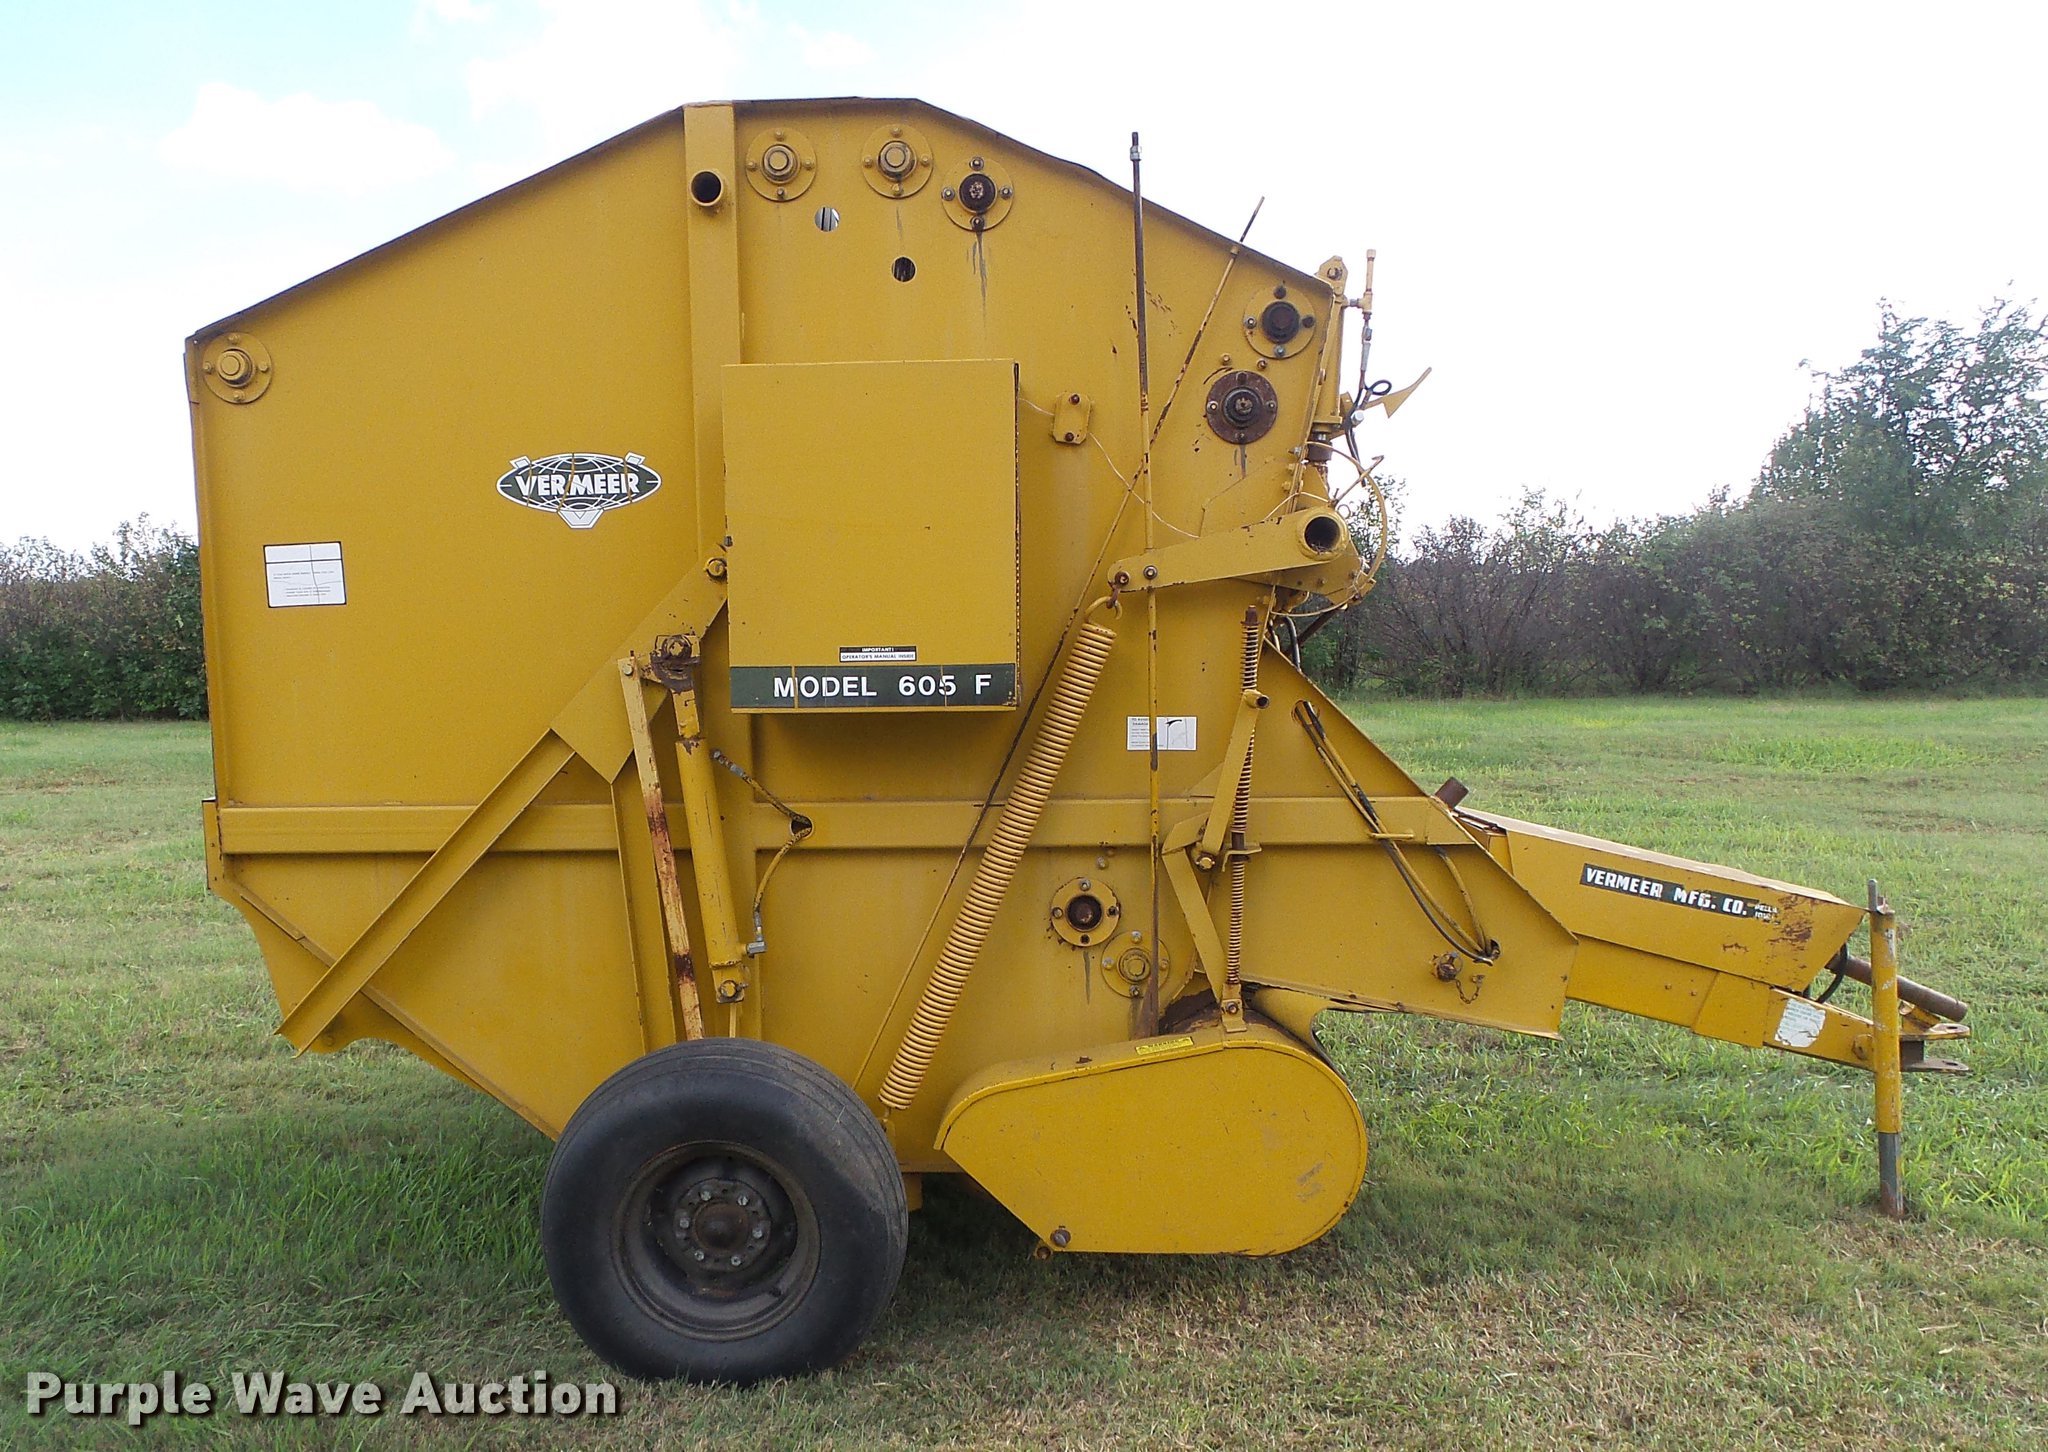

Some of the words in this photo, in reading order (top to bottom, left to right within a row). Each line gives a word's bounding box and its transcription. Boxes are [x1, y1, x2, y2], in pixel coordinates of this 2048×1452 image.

[515, 474, 640, 496] VERMEER
[773, 675, 877, 698] MODEL
[898, 674, 957, 697] 605
[975, 674, 992, 695] F
[1585, 867, 1664, 898] VERMEER
[1673, 887, 1716, 910] MFG.
[1722, 898, 1747, 915] CO.
